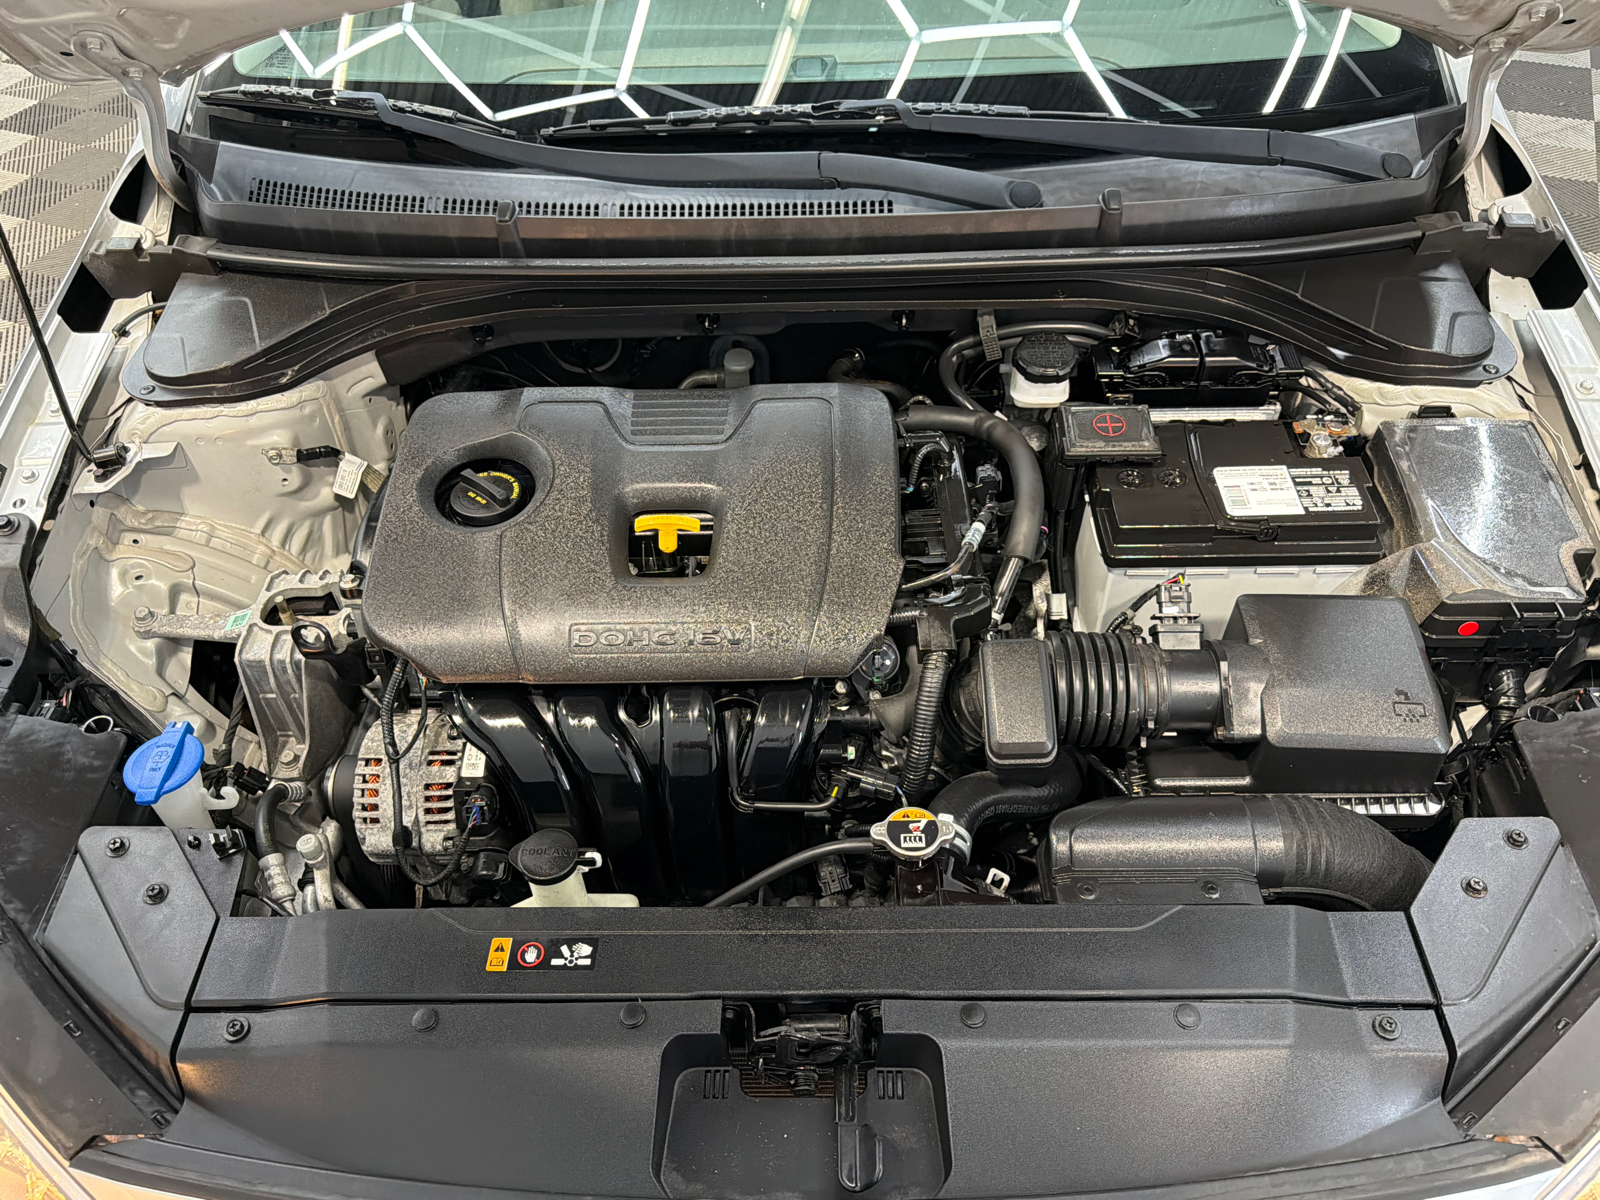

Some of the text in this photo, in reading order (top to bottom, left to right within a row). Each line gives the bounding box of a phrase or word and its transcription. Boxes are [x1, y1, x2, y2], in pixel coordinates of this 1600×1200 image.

[572, 628, 748, 647] DOHC 16V
[521, 847, 574, 857] COOLANT
